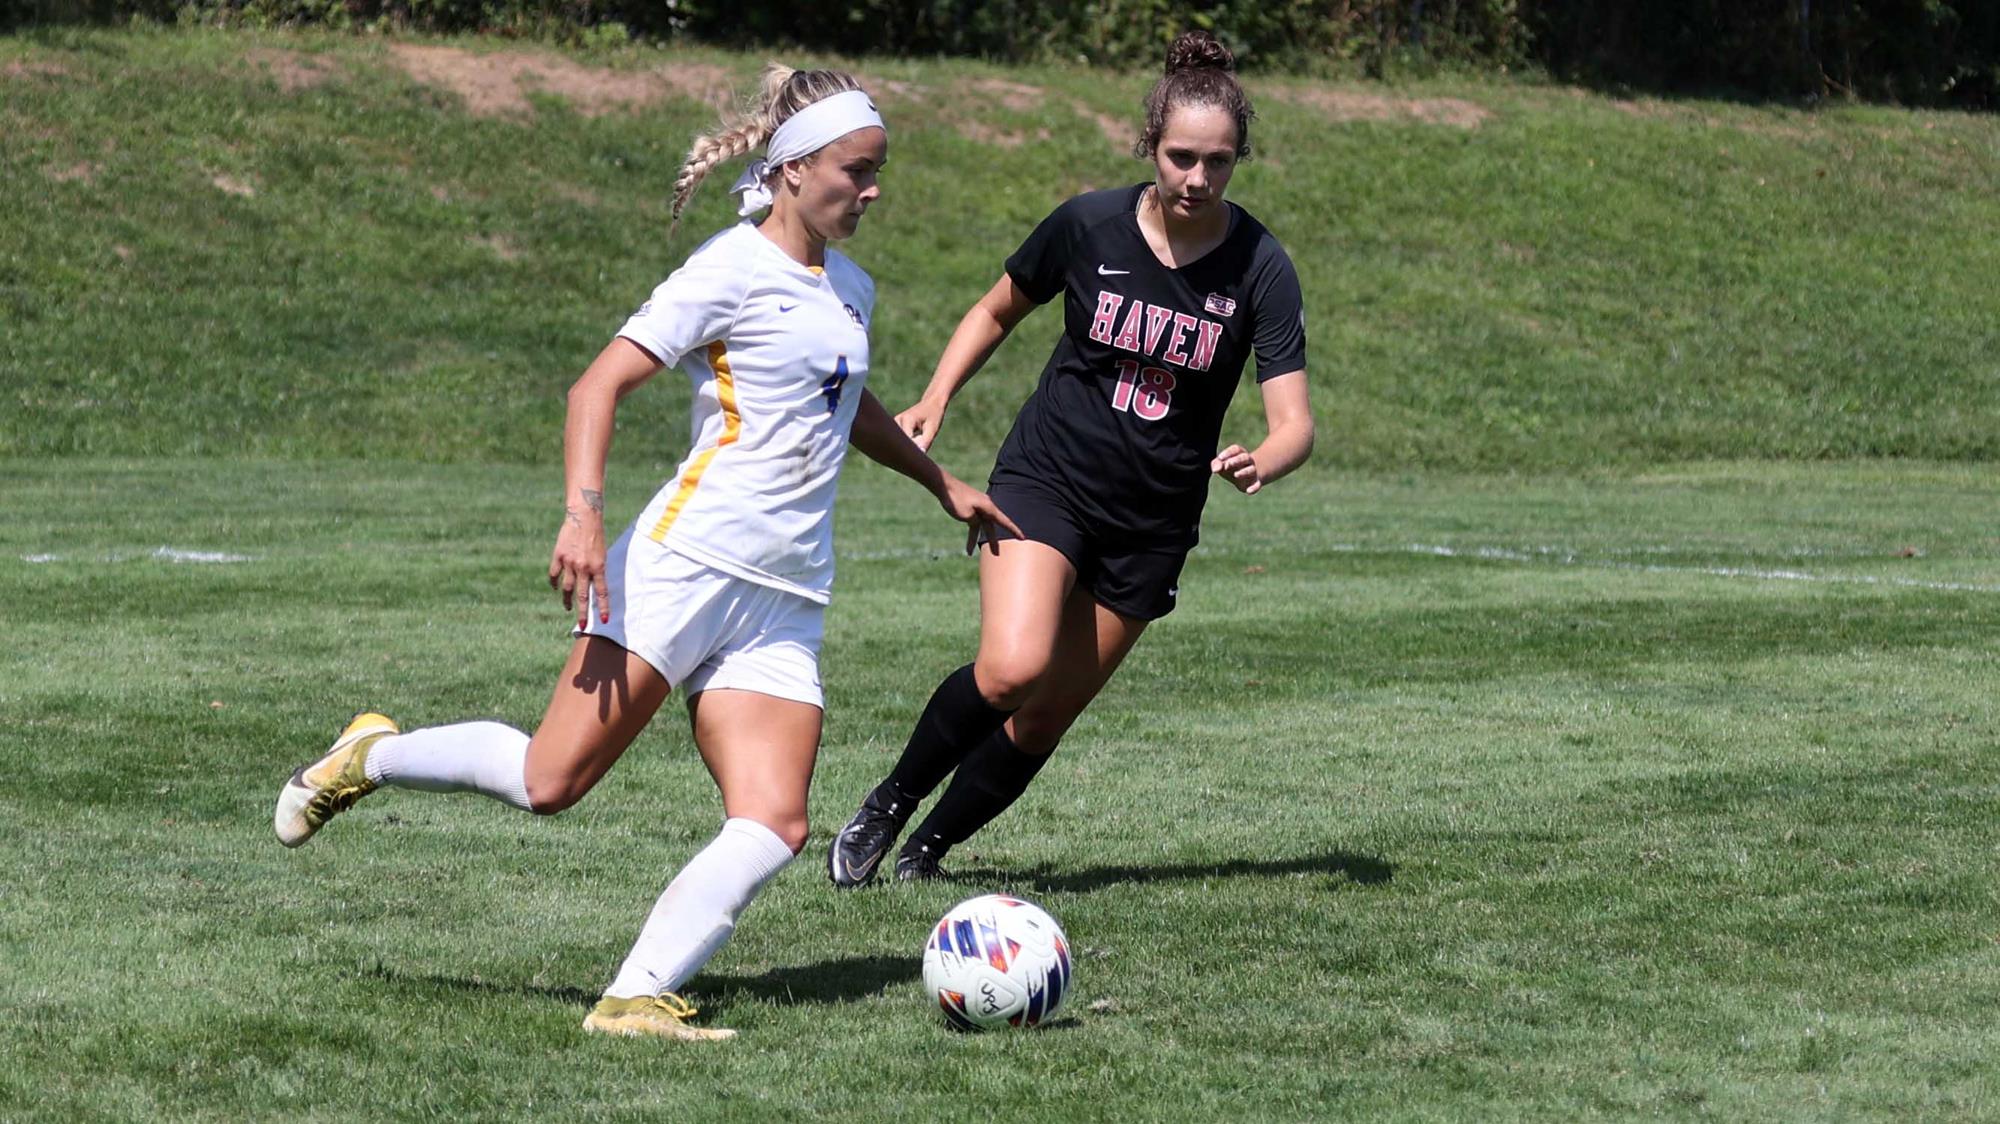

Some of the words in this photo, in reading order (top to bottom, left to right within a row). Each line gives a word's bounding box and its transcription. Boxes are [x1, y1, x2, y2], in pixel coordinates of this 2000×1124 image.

[1089, 291, 1223, 372] HAVEN
[1207, 297, 1235, 312] PSAC
[821, 355, 849, 415] 4
[1112, 359, 1177, 421] 18
